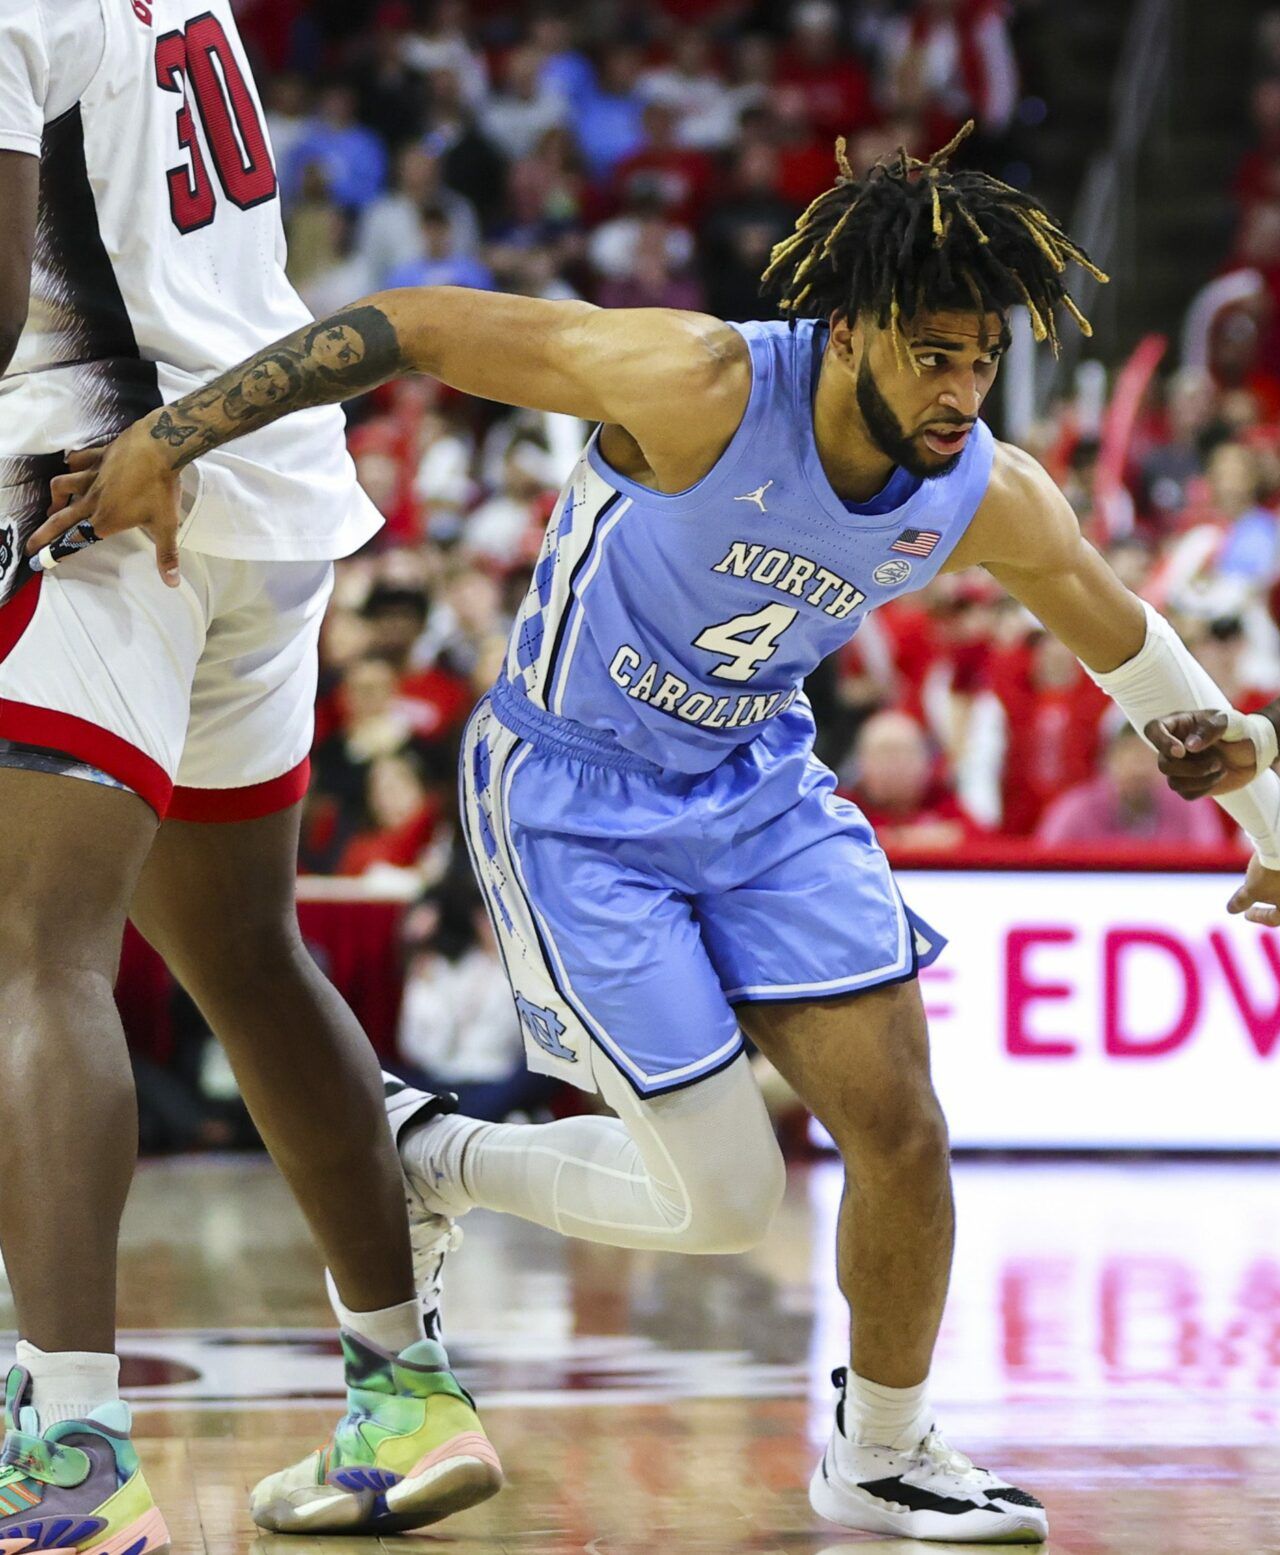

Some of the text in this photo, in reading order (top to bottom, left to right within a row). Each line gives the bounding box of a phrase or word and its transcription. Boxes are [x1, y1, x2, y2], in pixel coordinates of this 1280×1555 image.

[155, 11, 277, 236] 30
[713, 541, 866, 620] NORTH
[691, 601, 799, 682] 4
[608, 644, 798, 729] CAROLINA
